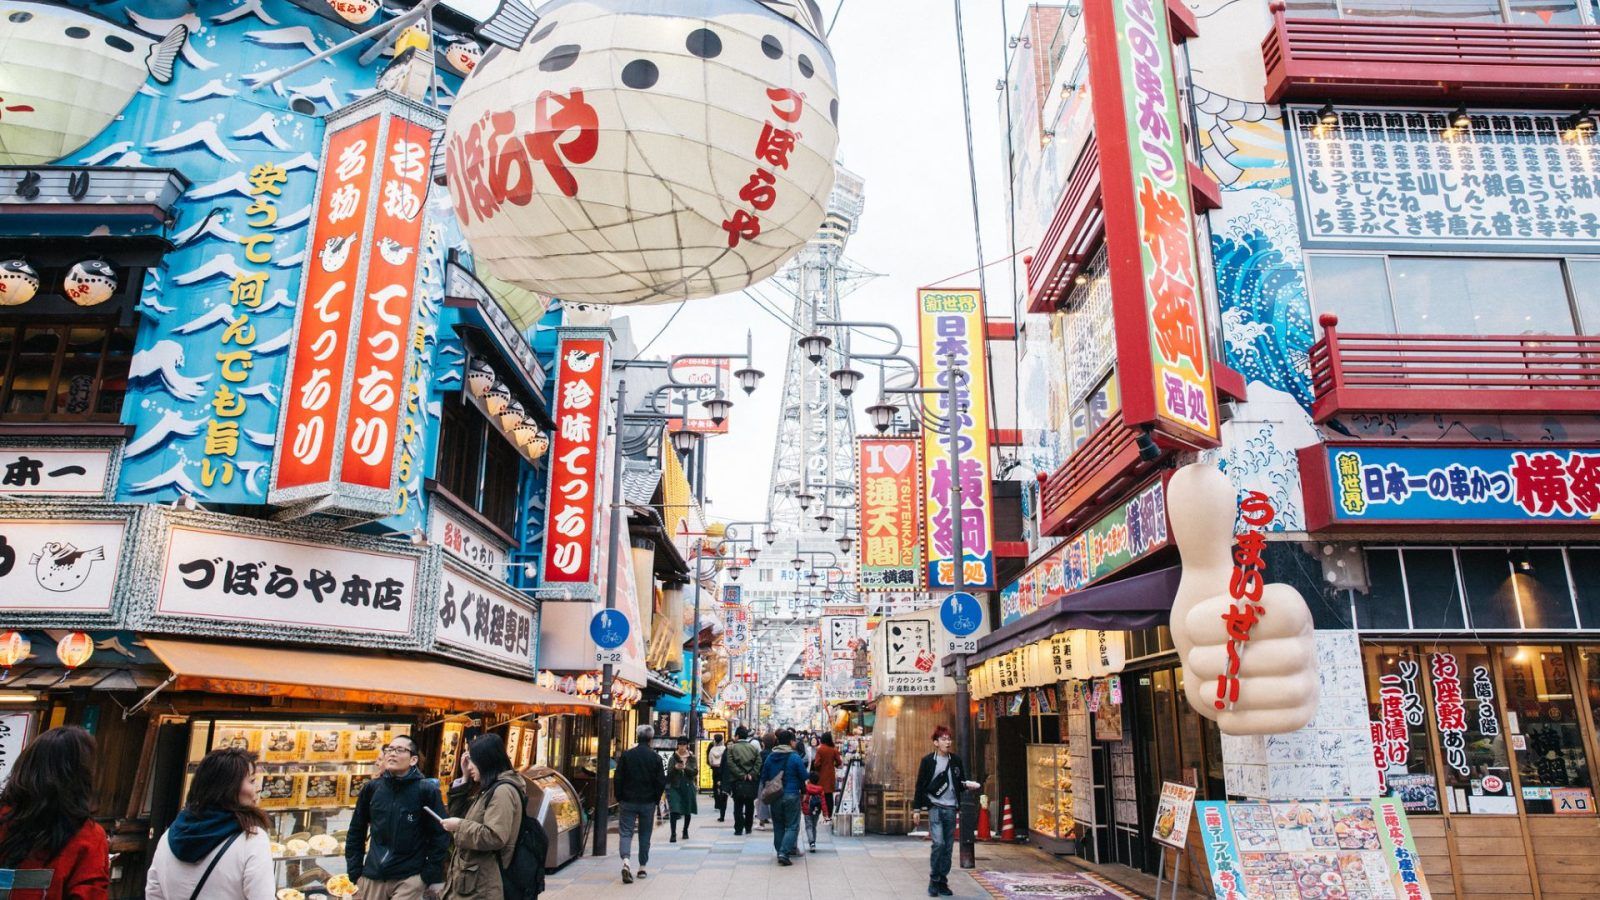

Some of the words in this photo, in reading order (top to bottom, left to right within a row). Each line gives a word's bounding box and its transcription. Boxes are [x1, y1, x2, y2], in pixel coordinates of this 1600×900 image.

[329, 137, 370, 224] 名物
[382, 138, 427, 221] 名物
[446, 87, 599, 226] づぼらや
[722, 87, 808, 248] づぼらや
[1309, 170, 1334, 233] もち
[1331, 170, 1358, 234] うずら玉子
[1352, 171, 1382, 234] 紅しょうが
[1373, 172, 1400, 235] にんにく
[1395, 172, 1423, 236] 玉ねぎ
[1461, 173, 1492, 236] れんこん
[1506, 174, 1533, 237] 白ねぎ
[1528, 174, 1557, 237] さつま芋
[1549, 174, 1580, 237] じゃが芋
[1138, 177, 1205, 380] 横綱
[199, 162, 290, 488] 安うて何んでも旨い
[292, 280, 348, 465] てっちり
[350, 283, 408, 467] てっちり
[1163, 373, 1208, 427] 酒処
[2, 456, 87, 487] 本一
[553, 379, 595, 575] 珍味てっちり
[1364, 466, 1512, 501] 日本一の串かつ
[866, 477, 900, 566] 通天閣
[901, 477, 914, 566] TSUTENKAKU
[931, 458, 987, 556] 横綱
[178, 558, 404, 612] づぼらや本店
[440, 581, 530, 657] ふぐ料理専門
[949, 641, 981, 651] 9-22
[597, 653, 621, 662] 9-22
[1380, 676, 1407, 763] 二度漬け
[1401, 662, 1421, 724] ソースの
[1560, 798, 1587, 809] 入口
